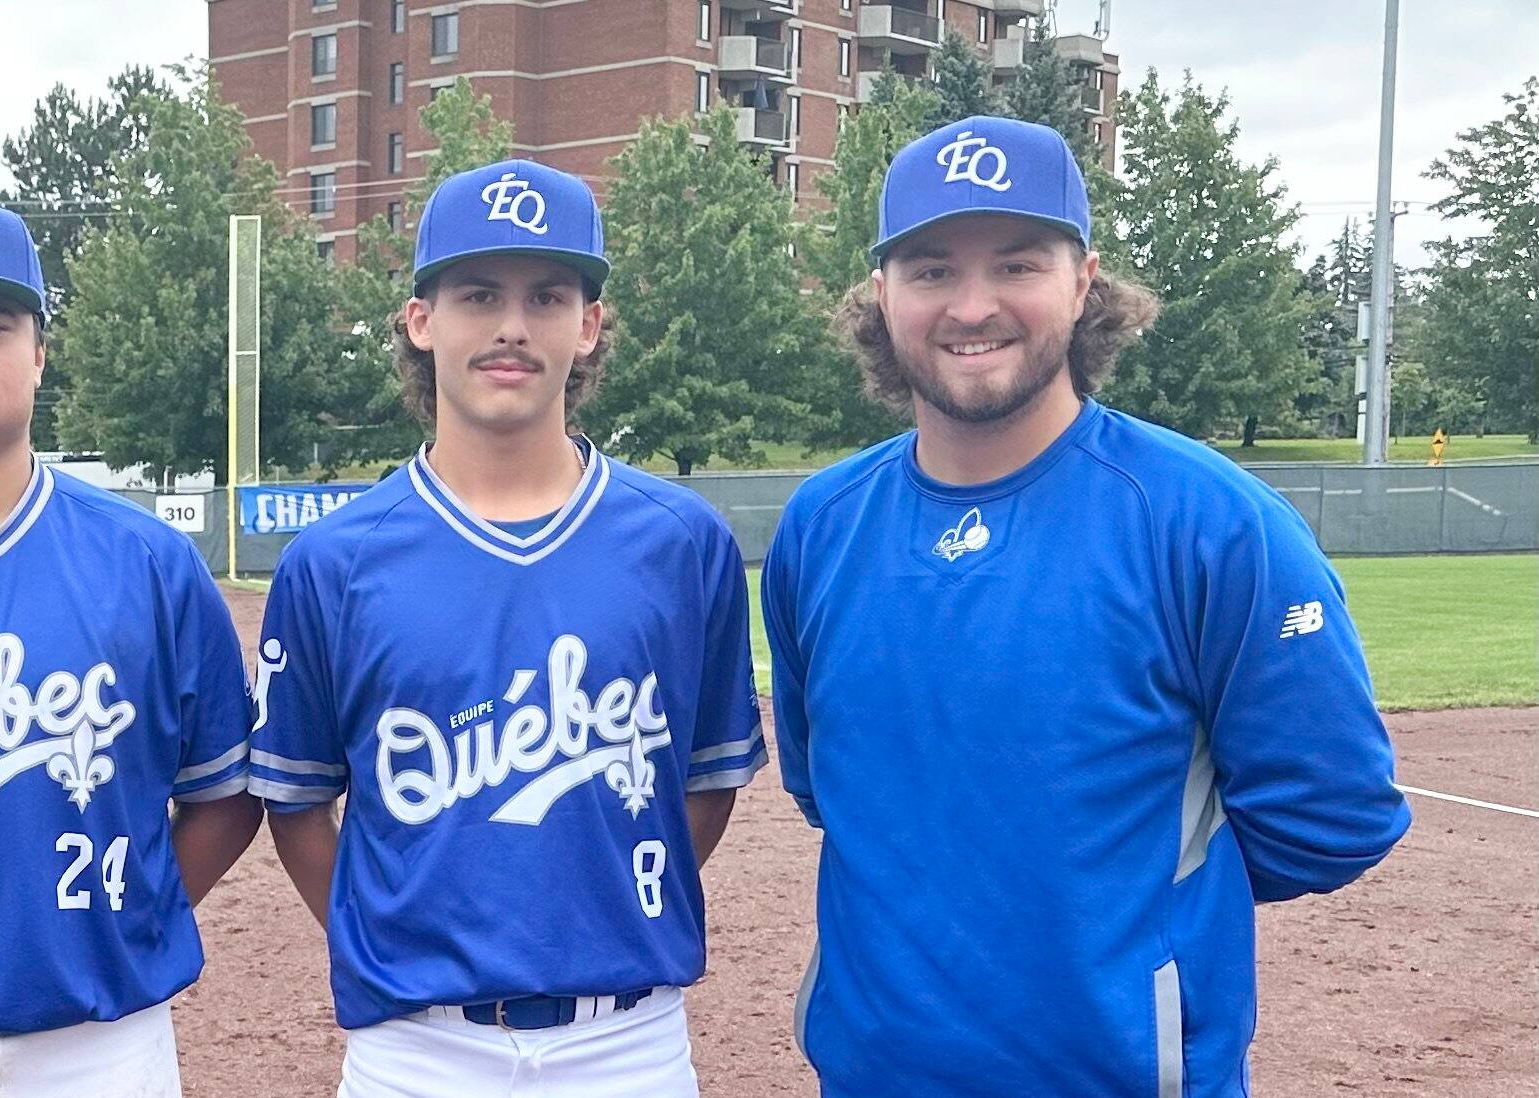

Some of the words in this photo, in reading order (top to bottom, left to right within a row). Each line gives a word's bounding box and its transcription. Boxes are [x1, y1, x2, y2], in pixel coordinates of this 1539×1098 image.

[164, 506, 196, 522] 310
[376, 634, 671, 826] Québec
[55, 832, 129, 911] 24
[632, 839, 667, 918] 8
